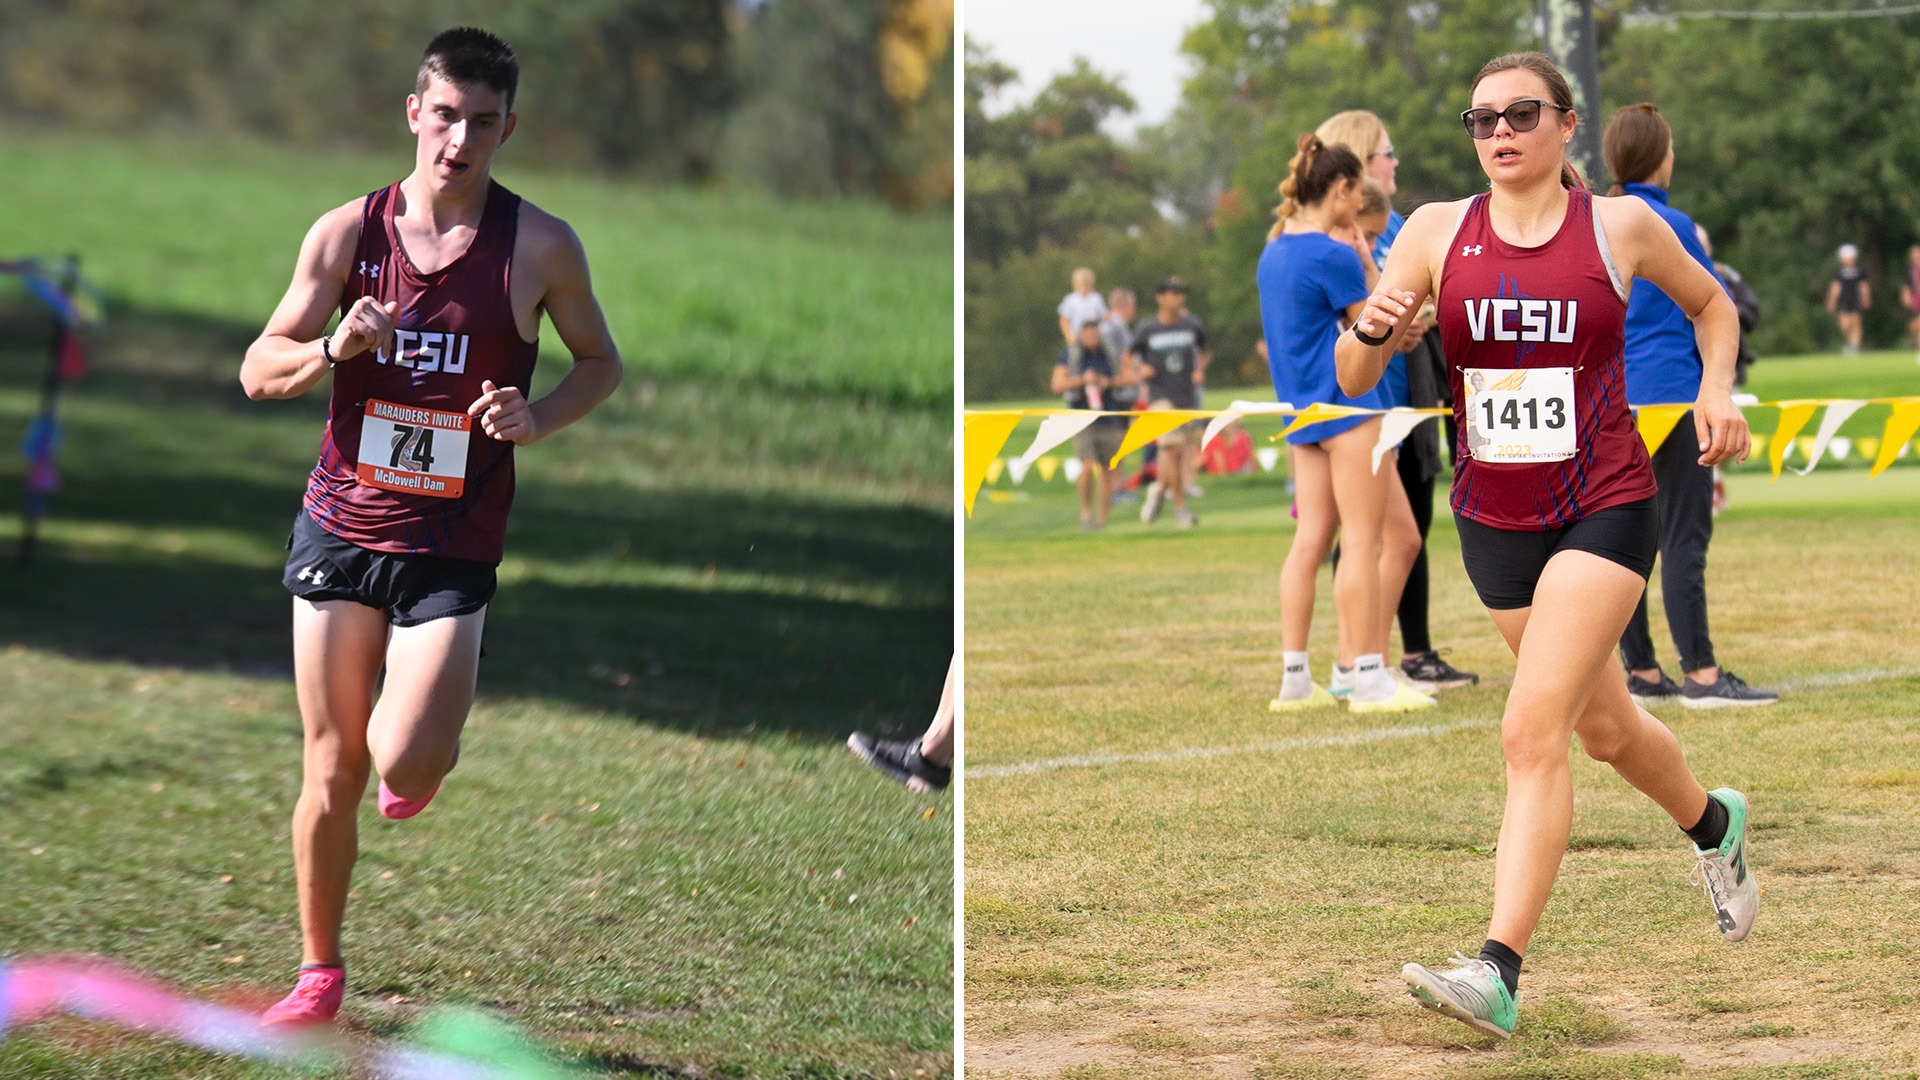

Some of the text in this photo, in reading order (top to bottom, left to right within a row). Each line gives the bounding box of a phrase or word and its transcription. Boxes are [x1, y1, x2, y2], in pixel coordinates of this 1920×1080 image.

[1463, 298, 1578, 344] VCSU
[373, 402, 464, 429] MARAUDERS INVITE
[1481, 396, 1567, 430] 1413
[389, 424, 435, 472] 74
[1496, 445, 1532, 456] 2023
[374, 469, 446, 491] McDowell Dam
